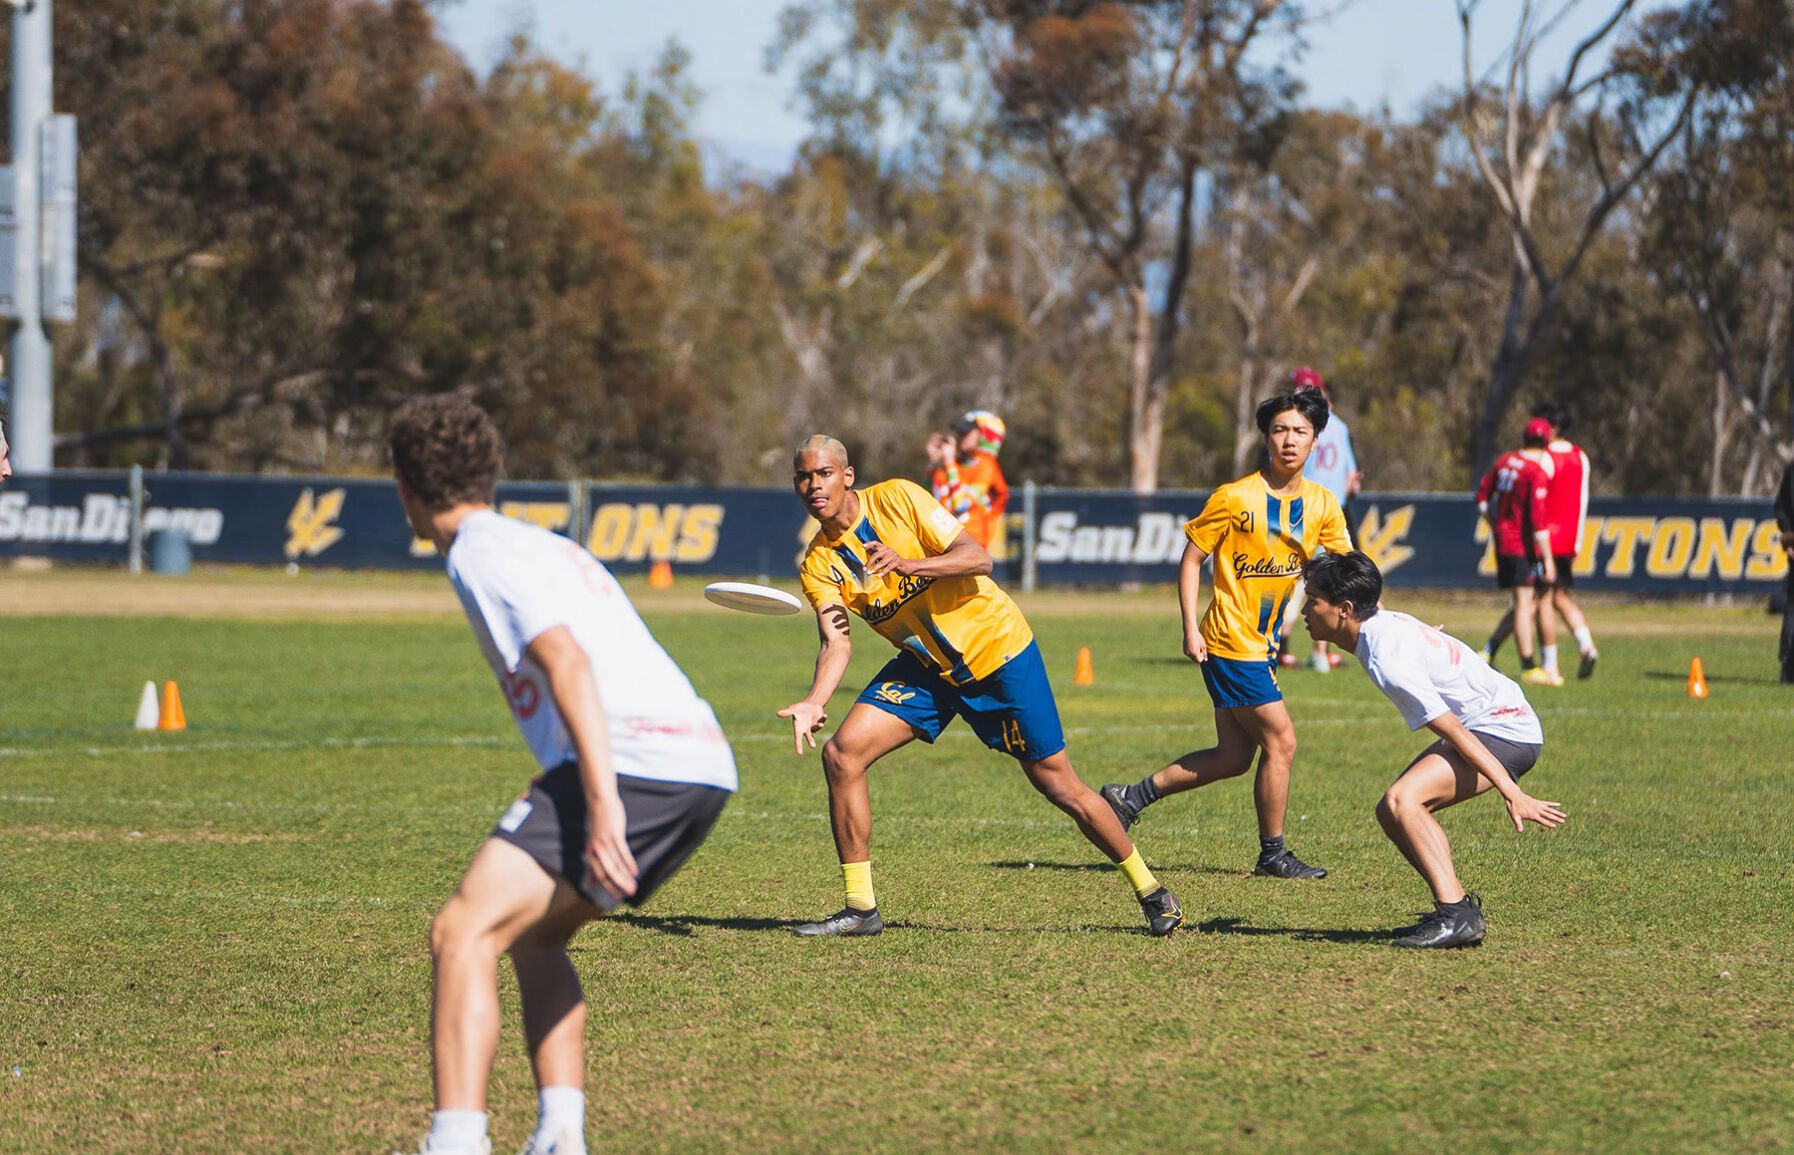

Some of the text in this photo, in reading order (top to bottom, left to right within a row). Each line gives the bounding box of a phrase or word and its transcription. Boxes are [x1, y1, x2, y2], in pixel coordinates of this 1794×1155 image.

[1240, 511, 1255, 534] 21
[1232, 551, 1284, 580] Golden
[876, 680, 916, 704] Cal
[1002, 719, 1026, 752] 14
